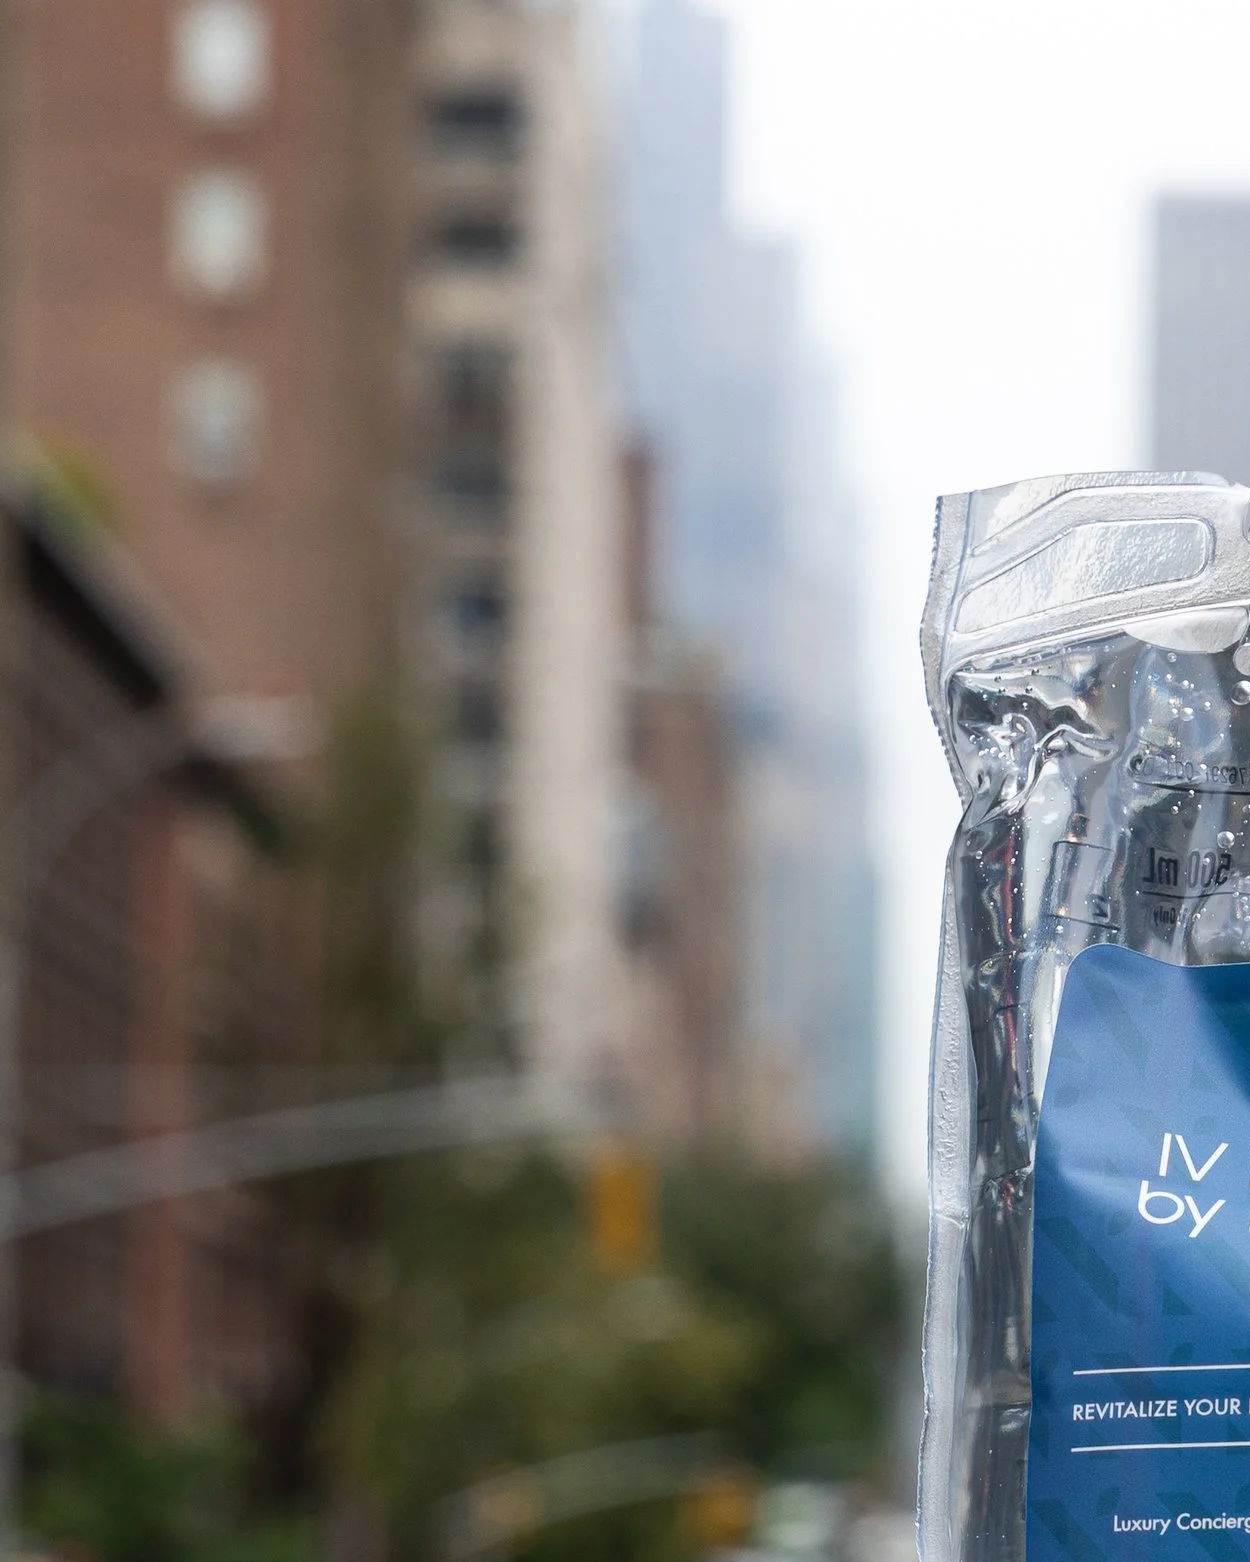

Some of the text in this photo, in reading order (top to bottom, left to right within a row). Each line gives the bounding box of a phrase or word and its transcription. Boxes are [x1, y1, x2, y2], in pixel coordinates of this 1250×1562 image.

[1160, 1133, 1229, 1181] IV
[1139, 1181, 1226, 1238] by
[1073, 1400, 1178, 1421] REVITALIZE
[1184, 1398, 1241, 1416] YOUR
[1113, 1514, 1171, 1535] Luxury
